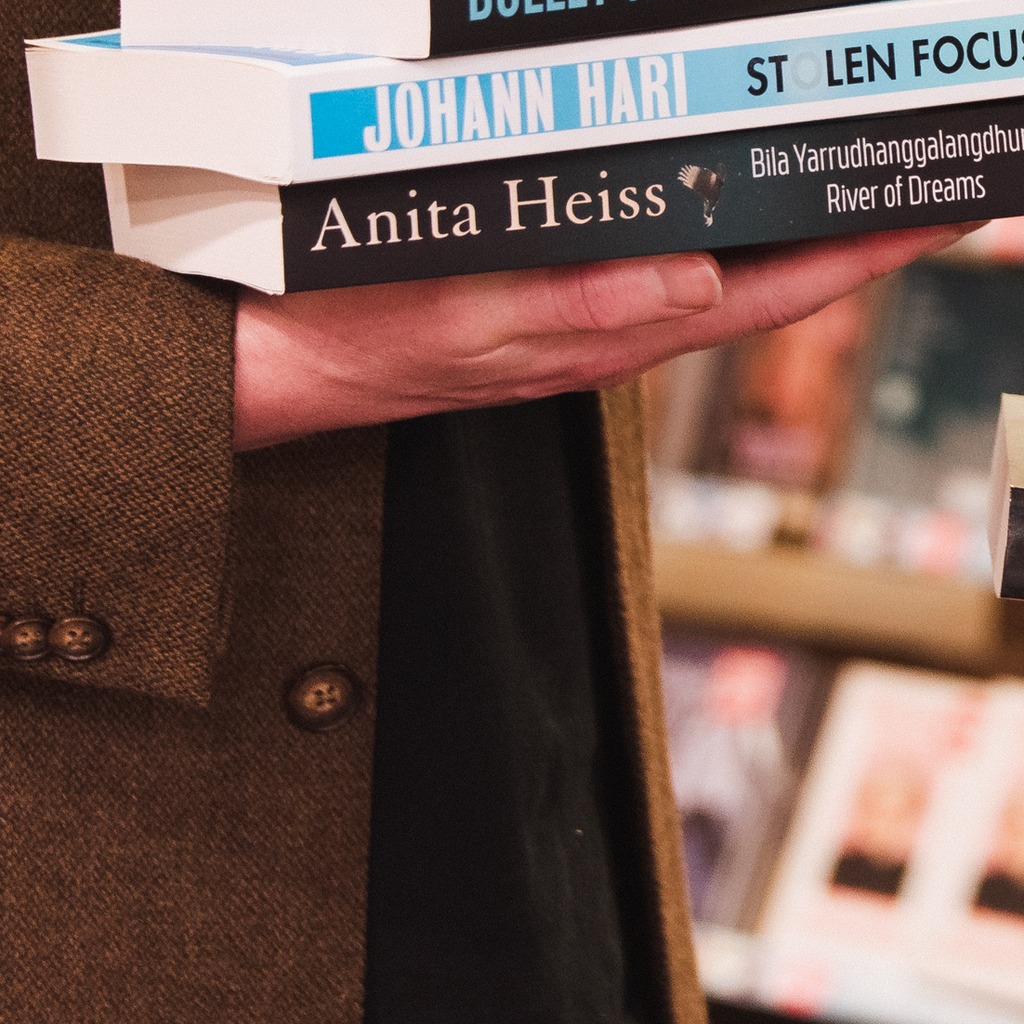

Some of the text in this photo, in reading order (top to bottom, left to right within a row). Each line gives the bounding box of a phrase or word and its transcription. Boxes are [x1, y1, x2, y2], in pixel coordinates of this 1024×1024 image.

[362, 67, 556, 153] JOHANN
[576, 51, 689, 128] HARI
[746, 42, 898, 97] STOLEN
[750, 146, 790, 179] Bila
[310, 170, 668, 252] Anita Heiss
[826, 174, 987, 215] River of Dreams
